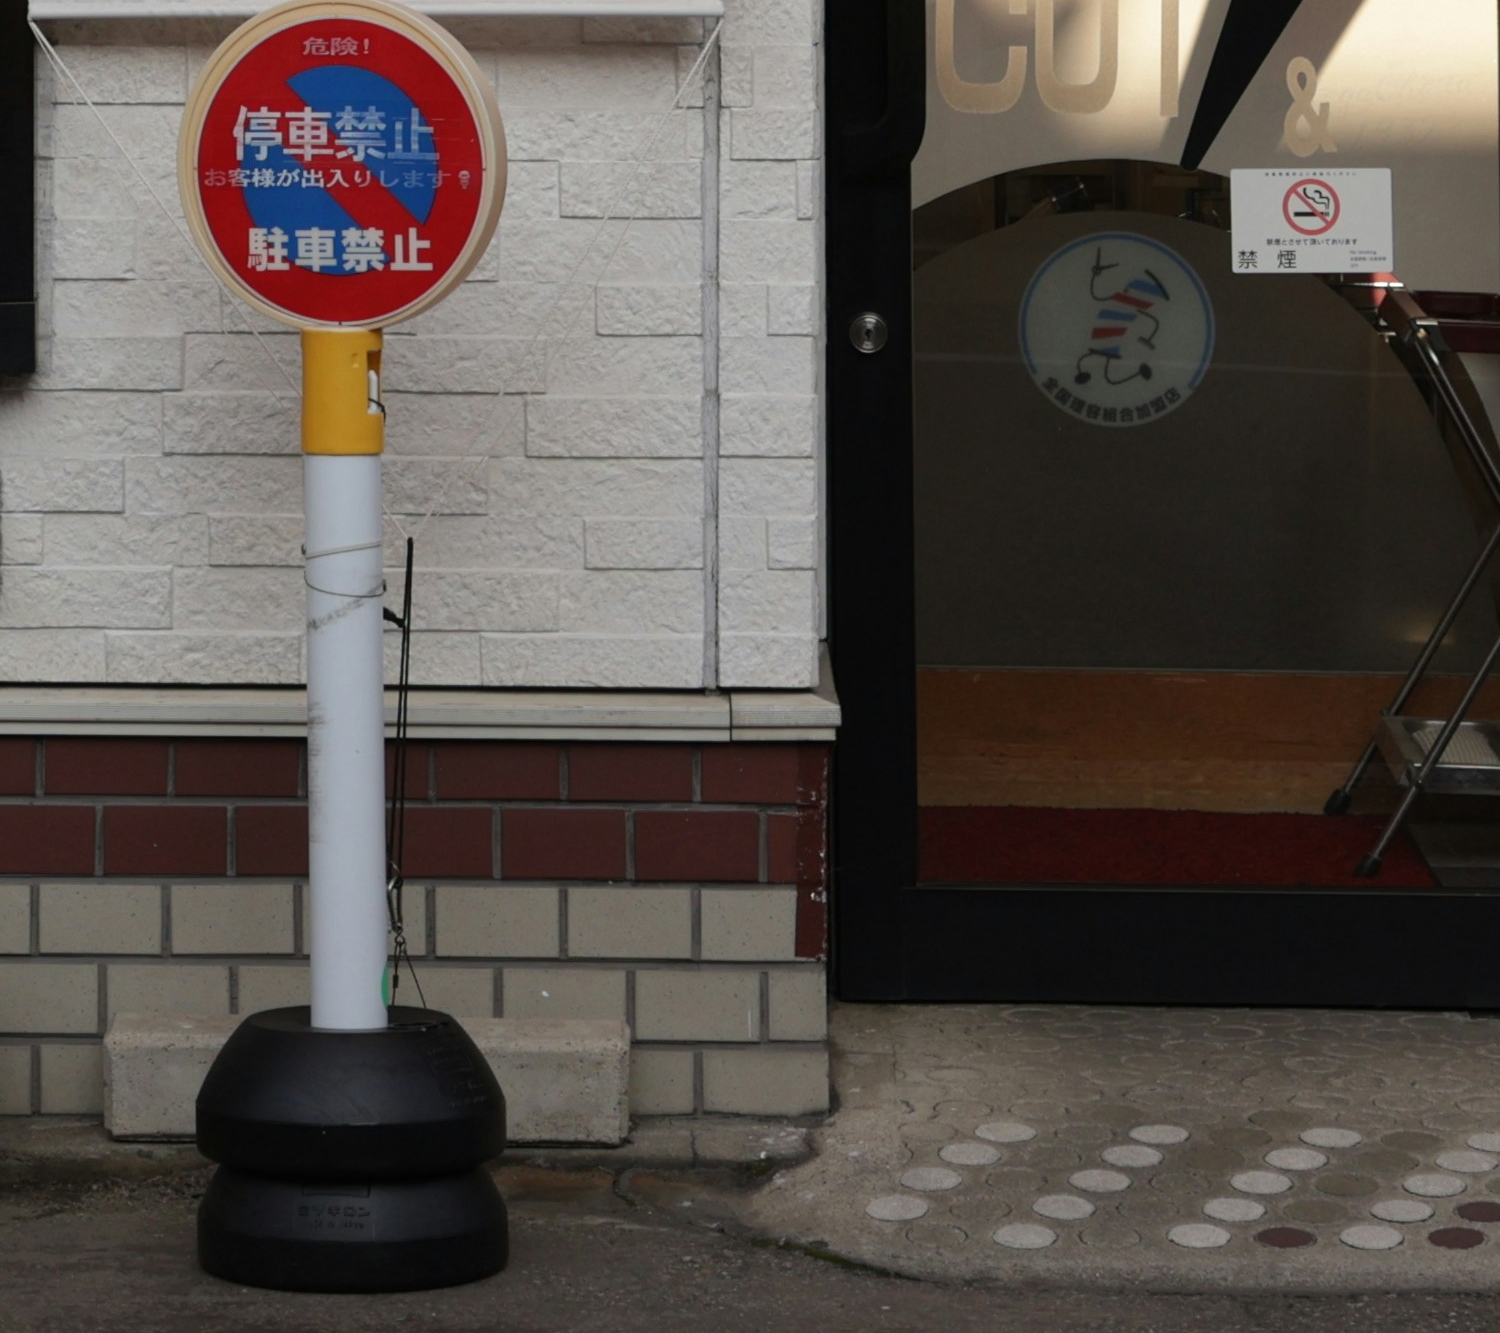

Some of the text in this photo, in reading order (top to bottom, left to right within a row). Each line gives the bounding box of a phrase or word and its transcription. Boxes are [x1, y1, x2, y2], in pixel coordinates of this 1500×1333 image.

[302, 36, 371, 56] 危険!
[1282, 55, 1338, 158] &
[232, 105, 441, 162] 停車禁止
[203, 168, 452, 189] お客様が出入りします
[246, 226, 434, 273] 駐車禁止
[1041, 376, 1182, 424] 全国理容組合加盟店
